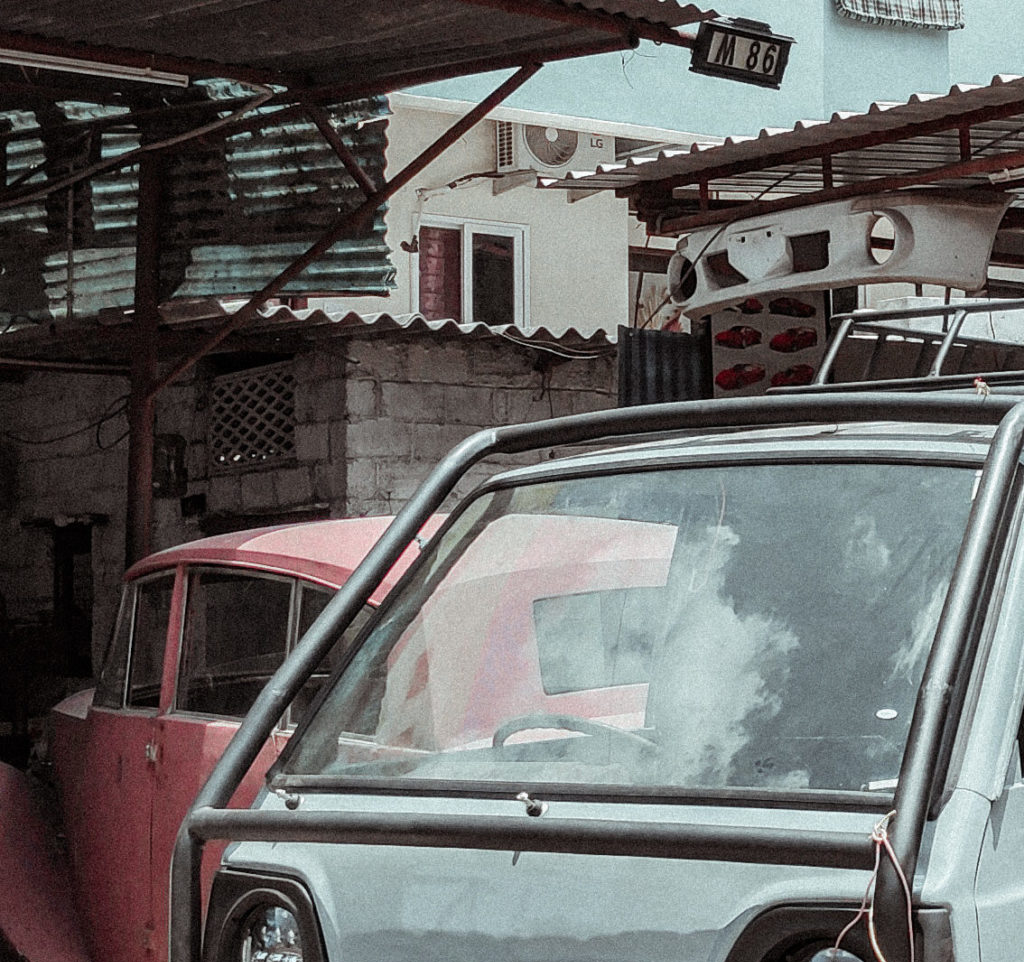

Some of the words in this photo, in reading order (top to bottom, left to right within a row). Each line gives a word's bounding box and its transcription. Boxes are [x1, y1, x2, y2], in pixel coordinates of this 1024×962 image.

[714, 34, 736, 65] M
[746, 41, 777, 73] 86
[590, 138, 603, 148] LG
